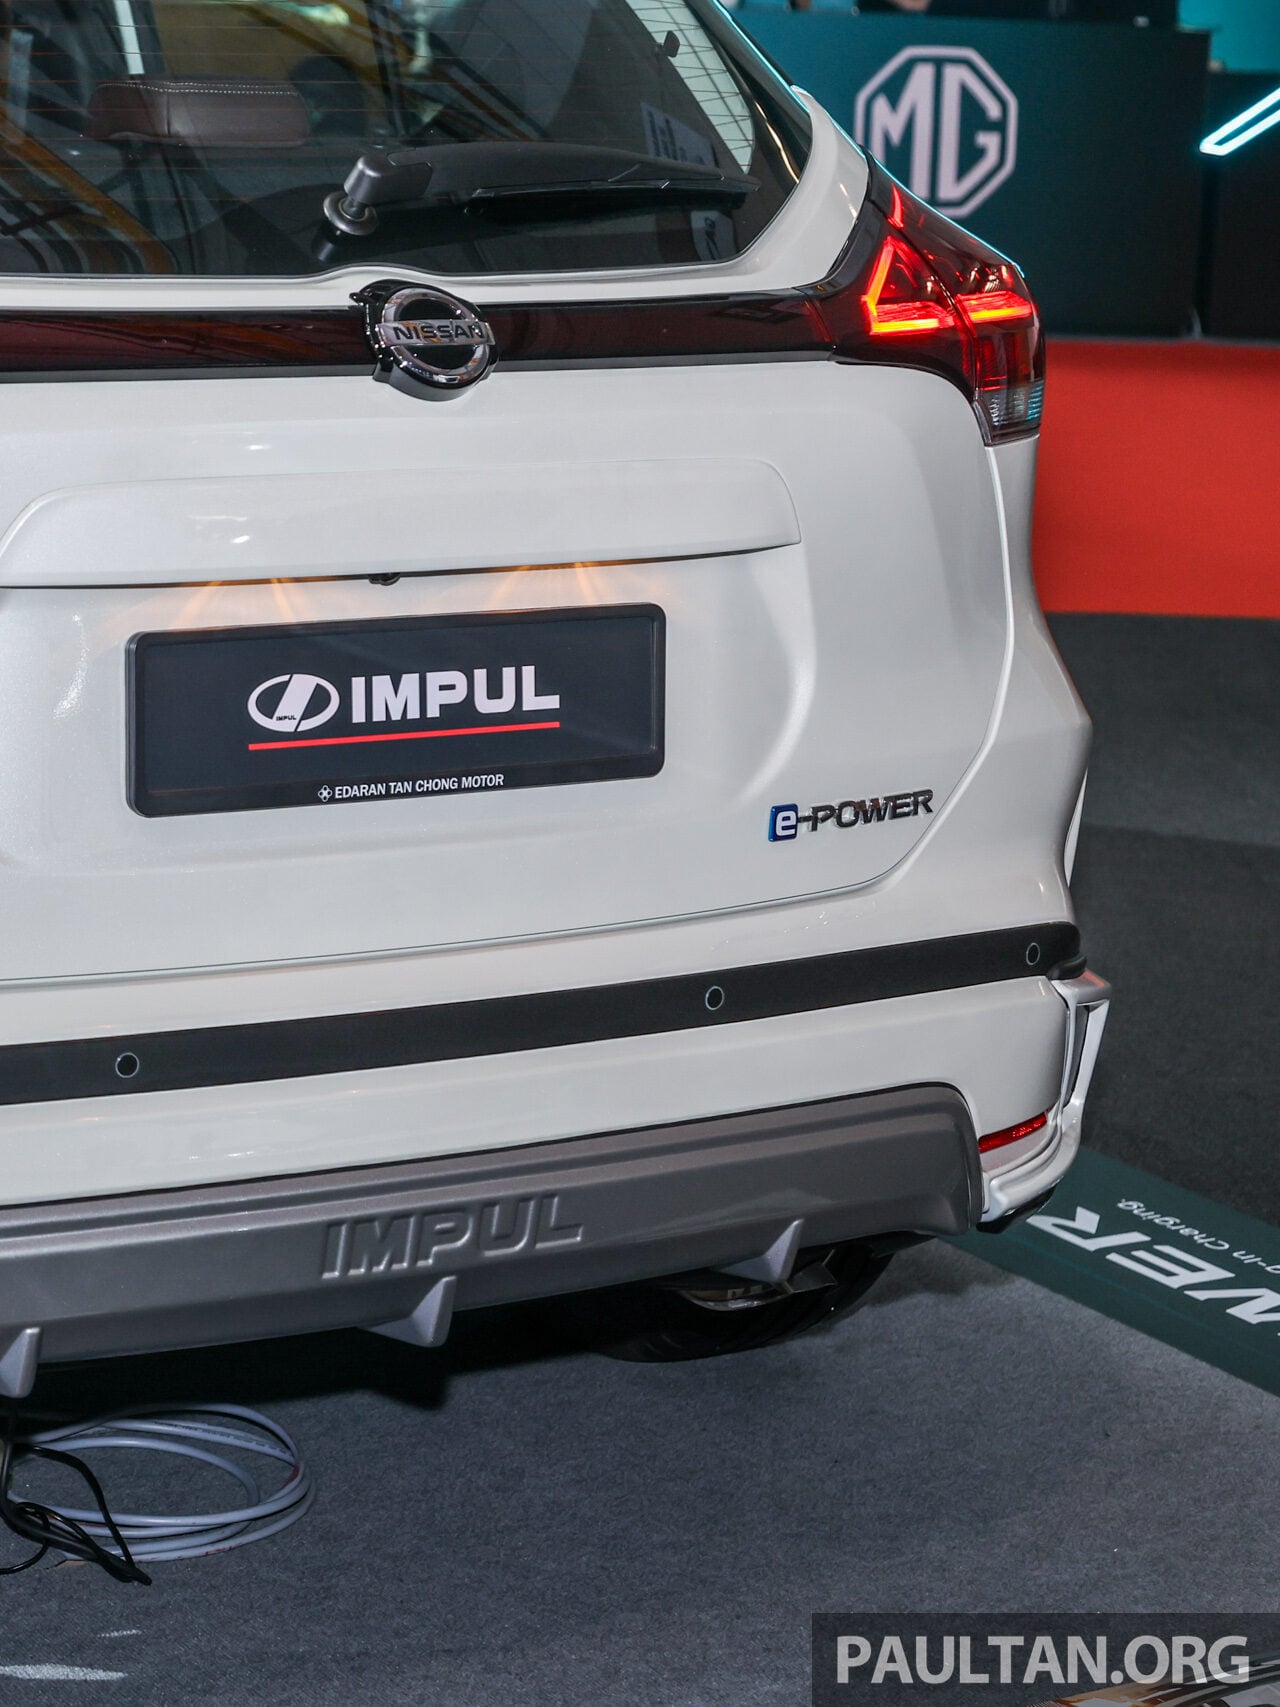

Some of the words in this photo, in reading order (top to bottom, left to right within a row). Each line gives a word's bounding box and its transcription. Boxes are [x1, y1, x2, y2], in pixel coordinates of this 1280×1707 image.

[871, 62, 1003, 202] MG
[392, 320, 485, 341] NISSAN
[351, 665, 560, 723] IMPUL
[334, 783, 386, 799] EDARAN
[389, 781, 413, 794] TAN
[415, 777, 458, 792] CHONG
[461, 774, 505, 789] MOTOR
[321, 1194, 585, 1279] IMPUL
